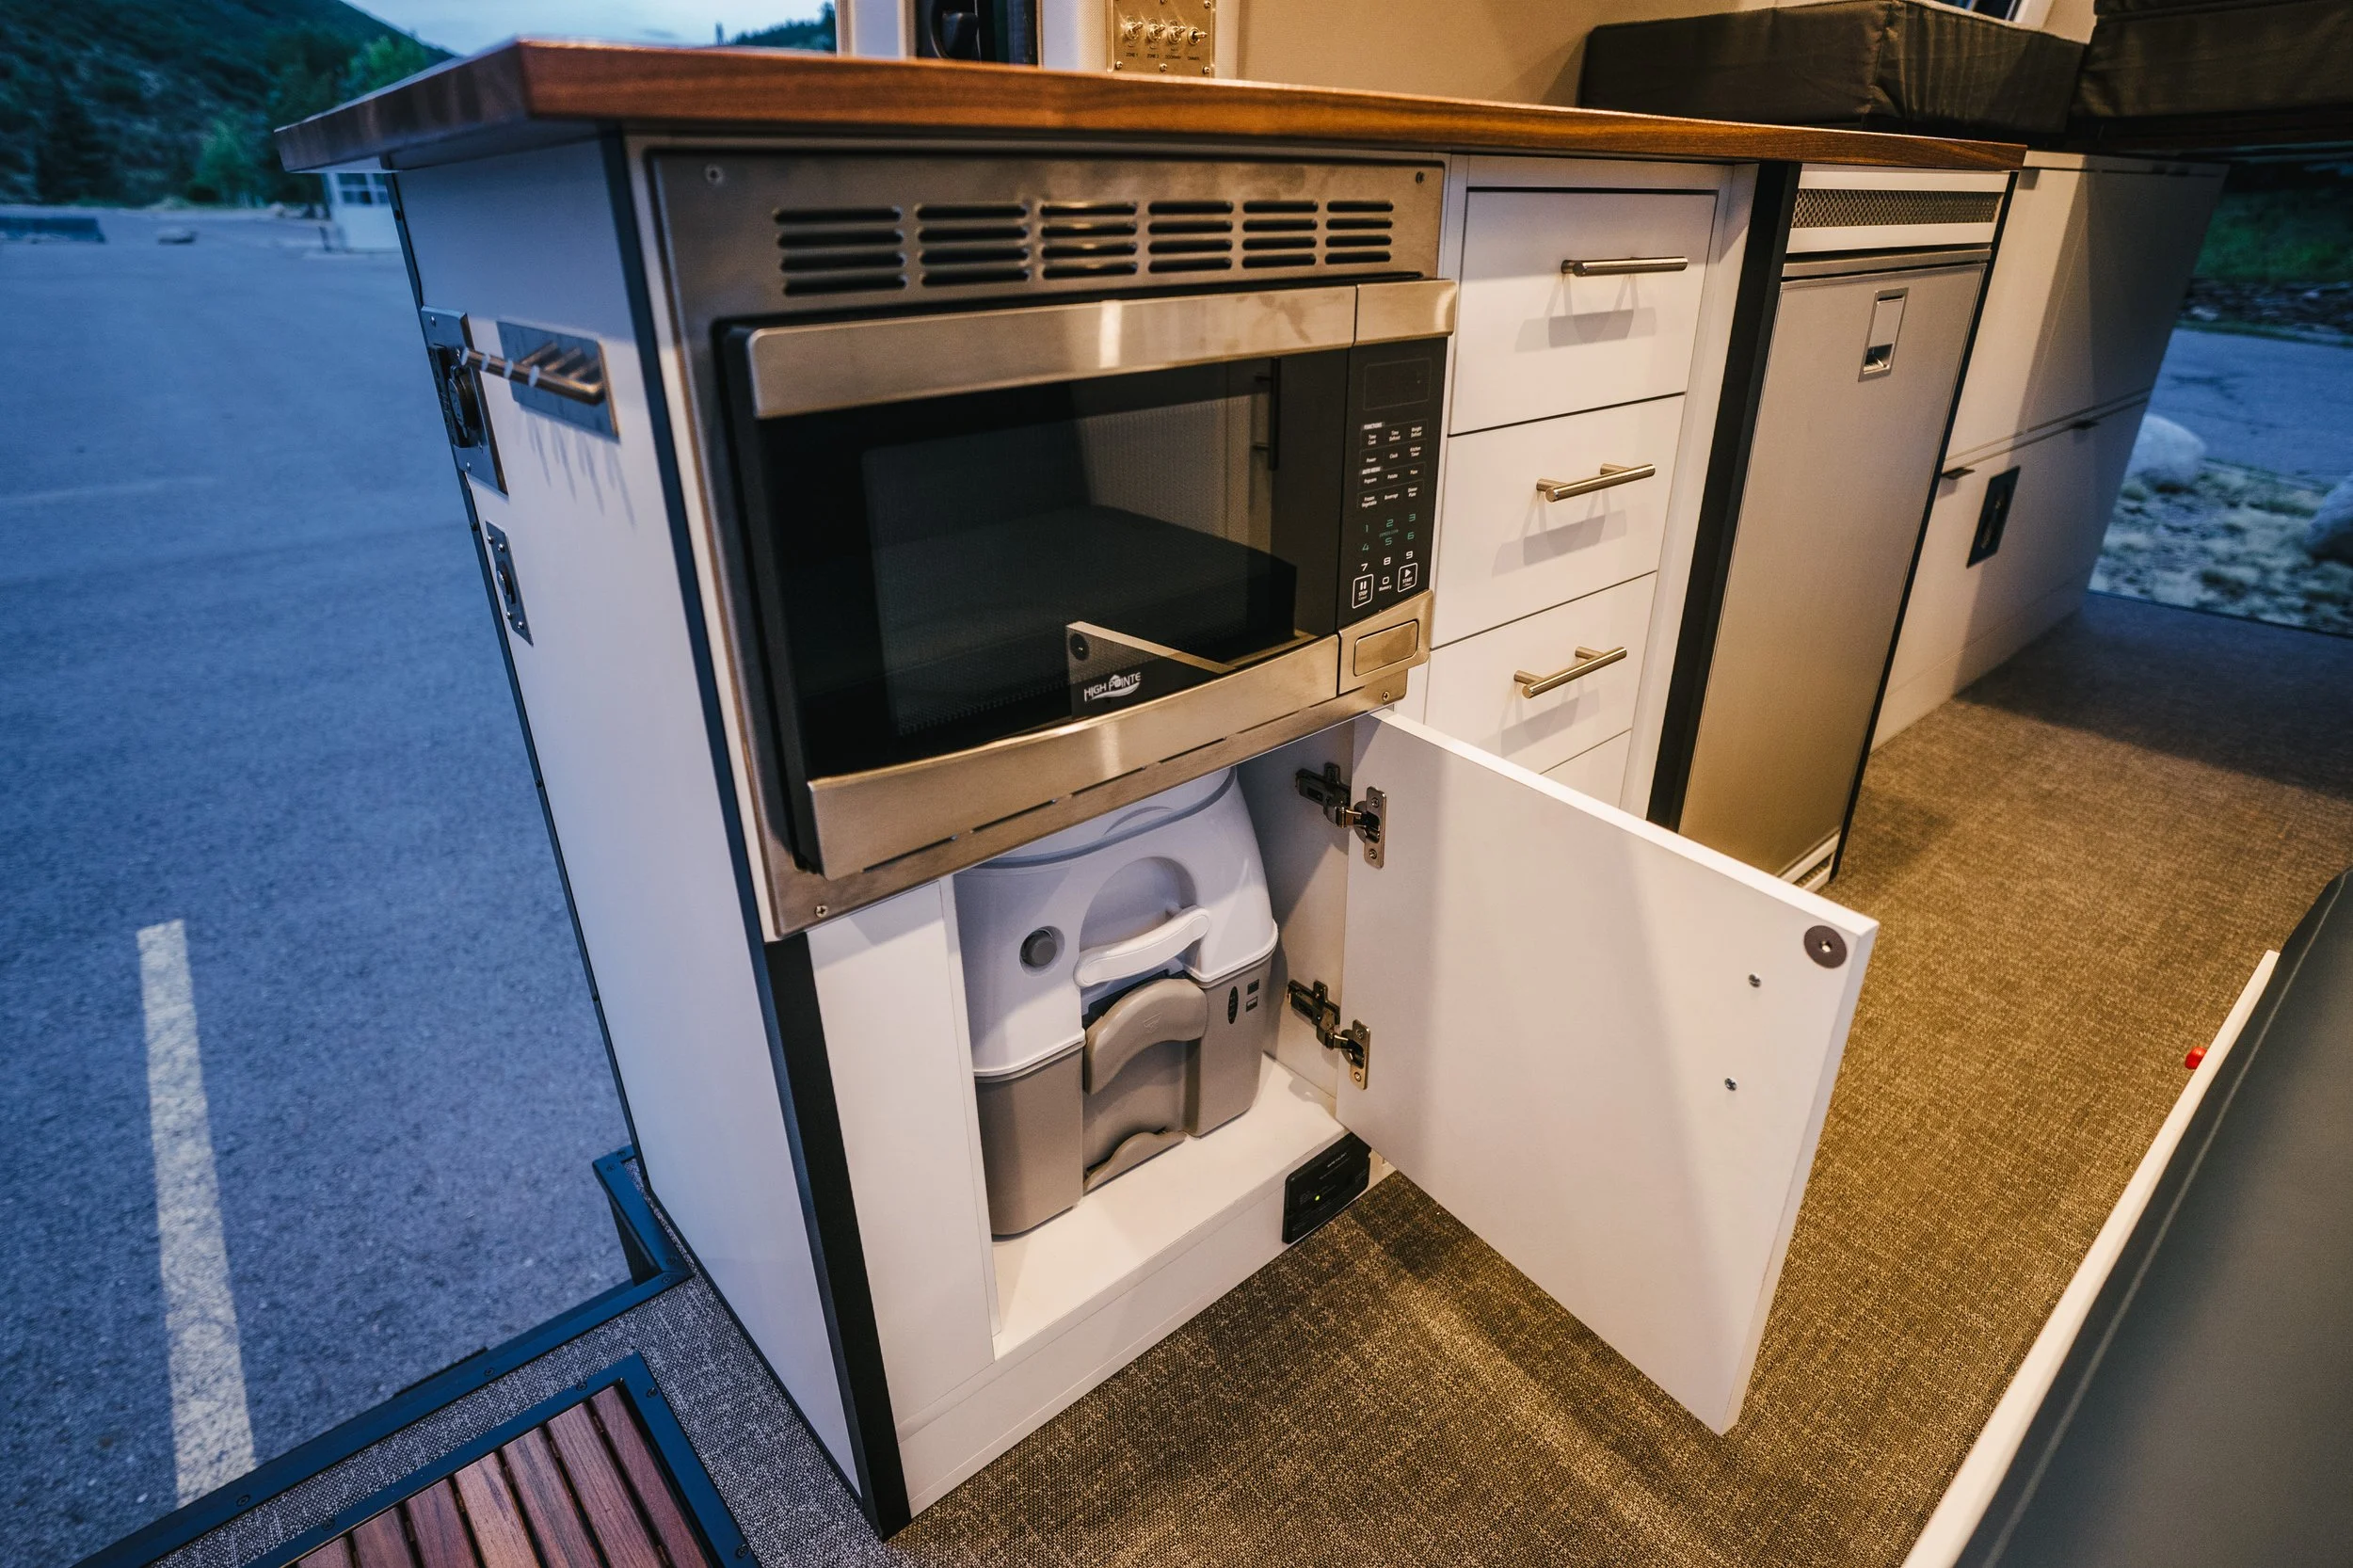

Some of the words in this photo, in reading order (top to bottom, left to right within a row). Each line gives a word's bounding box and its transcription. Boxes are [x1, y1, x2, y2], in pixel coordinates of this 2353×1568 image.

[1386, 519, 1393, 527] 2
[1407, 532, 1415, 540] 6
[1385, 537, 1392, 546] 5
[1405, 551, 1414, 559] 9
[1384, 556, 1391, 566] 8
[1361, 563, 1369, 571] 7
[1083, 682, 1107, 702] HIGH
[1109, 672, 1142, 691] POINTE
